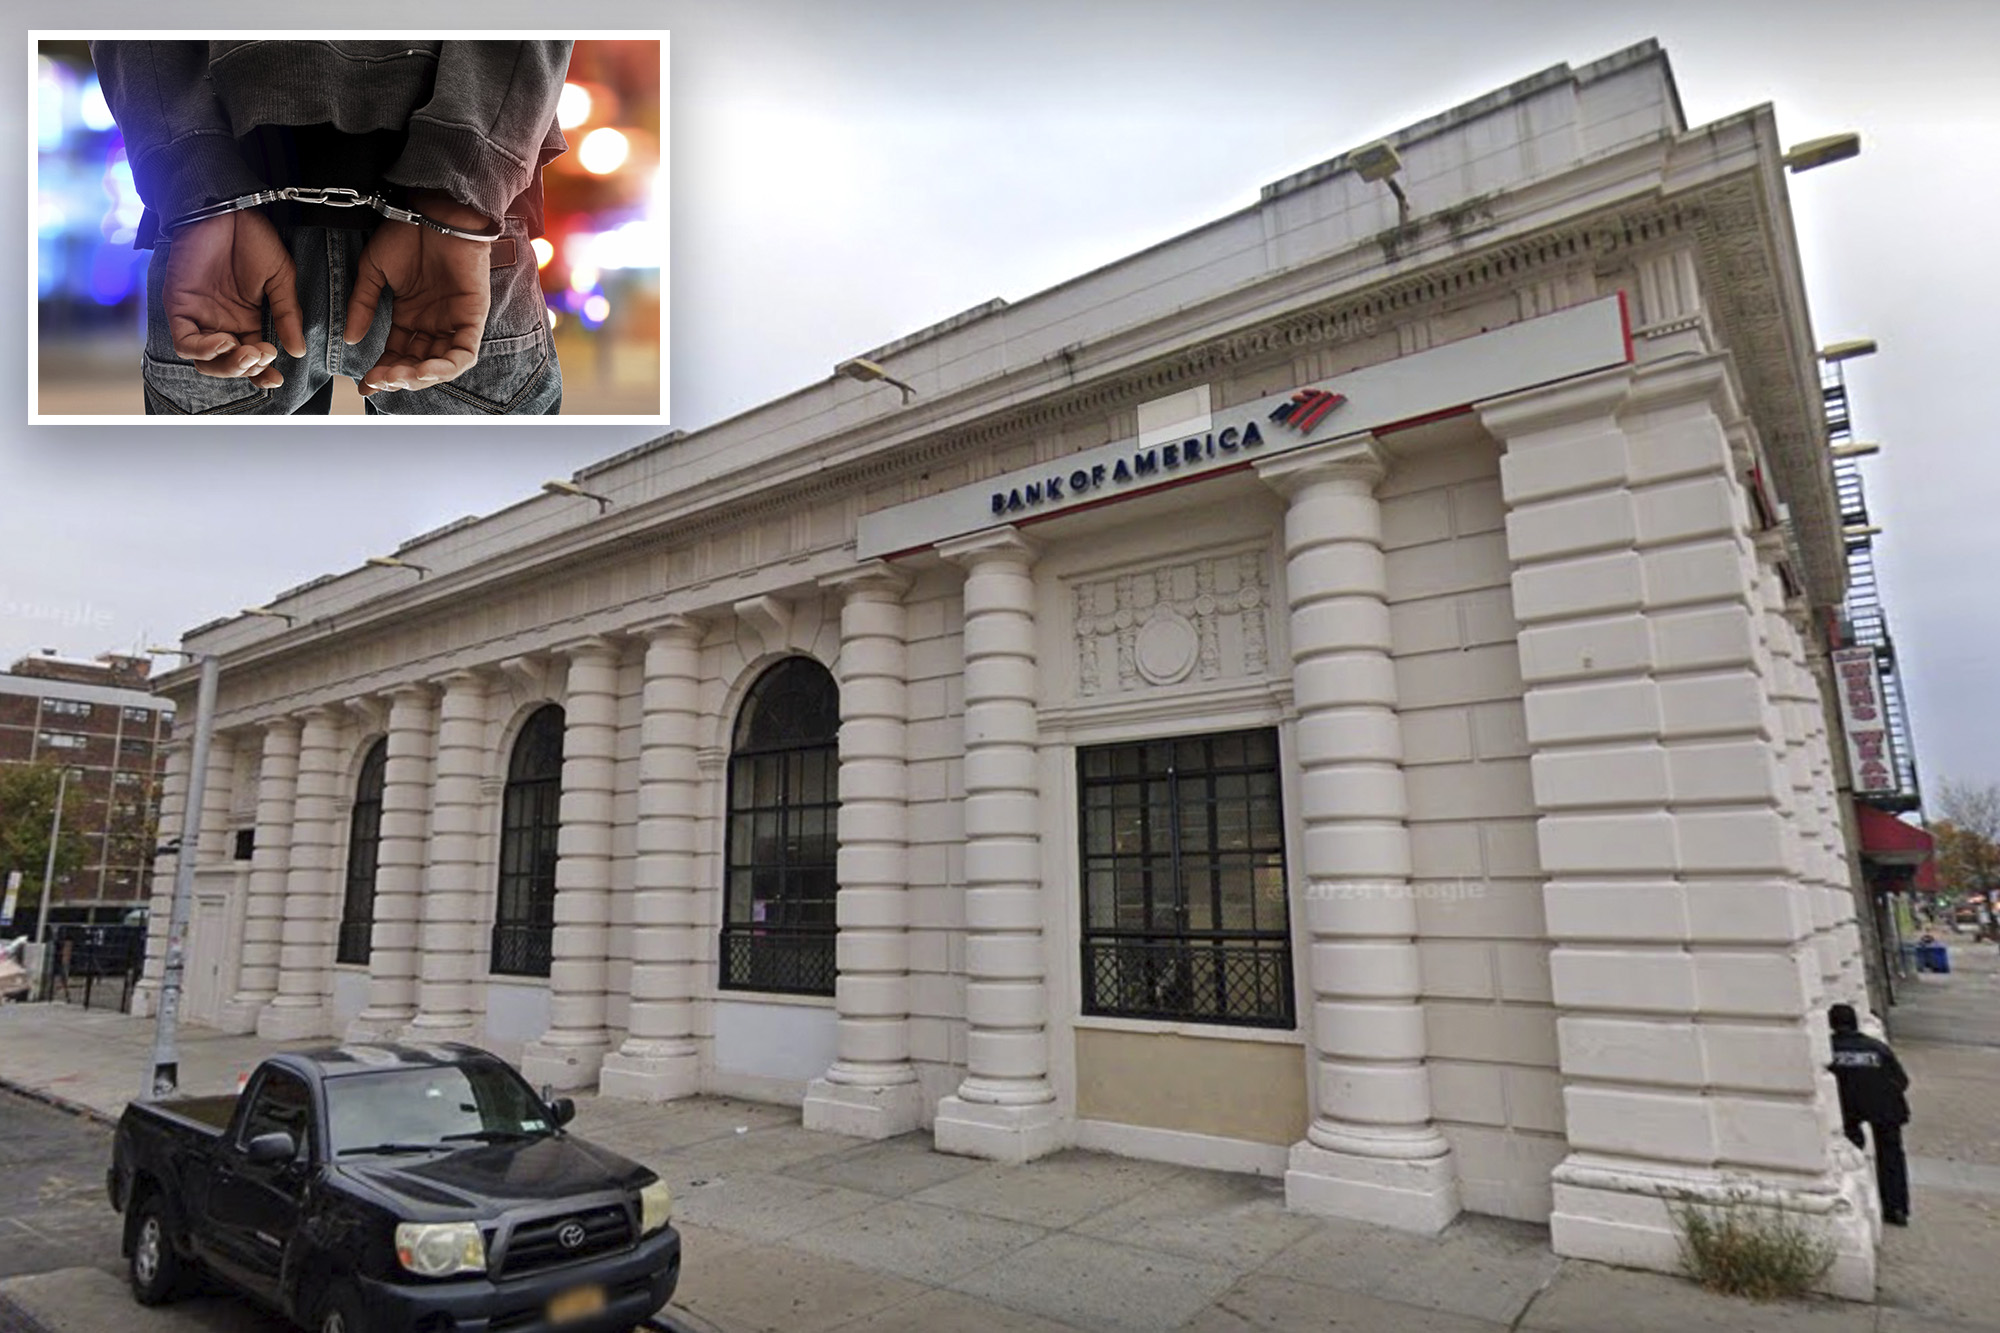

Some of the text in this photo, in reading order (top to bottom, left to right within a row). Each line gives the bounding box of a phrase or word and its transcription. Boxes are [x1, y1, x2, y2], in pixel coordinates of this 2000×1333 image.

[990, 421, 1265, 515] BANK OF AMERICA
